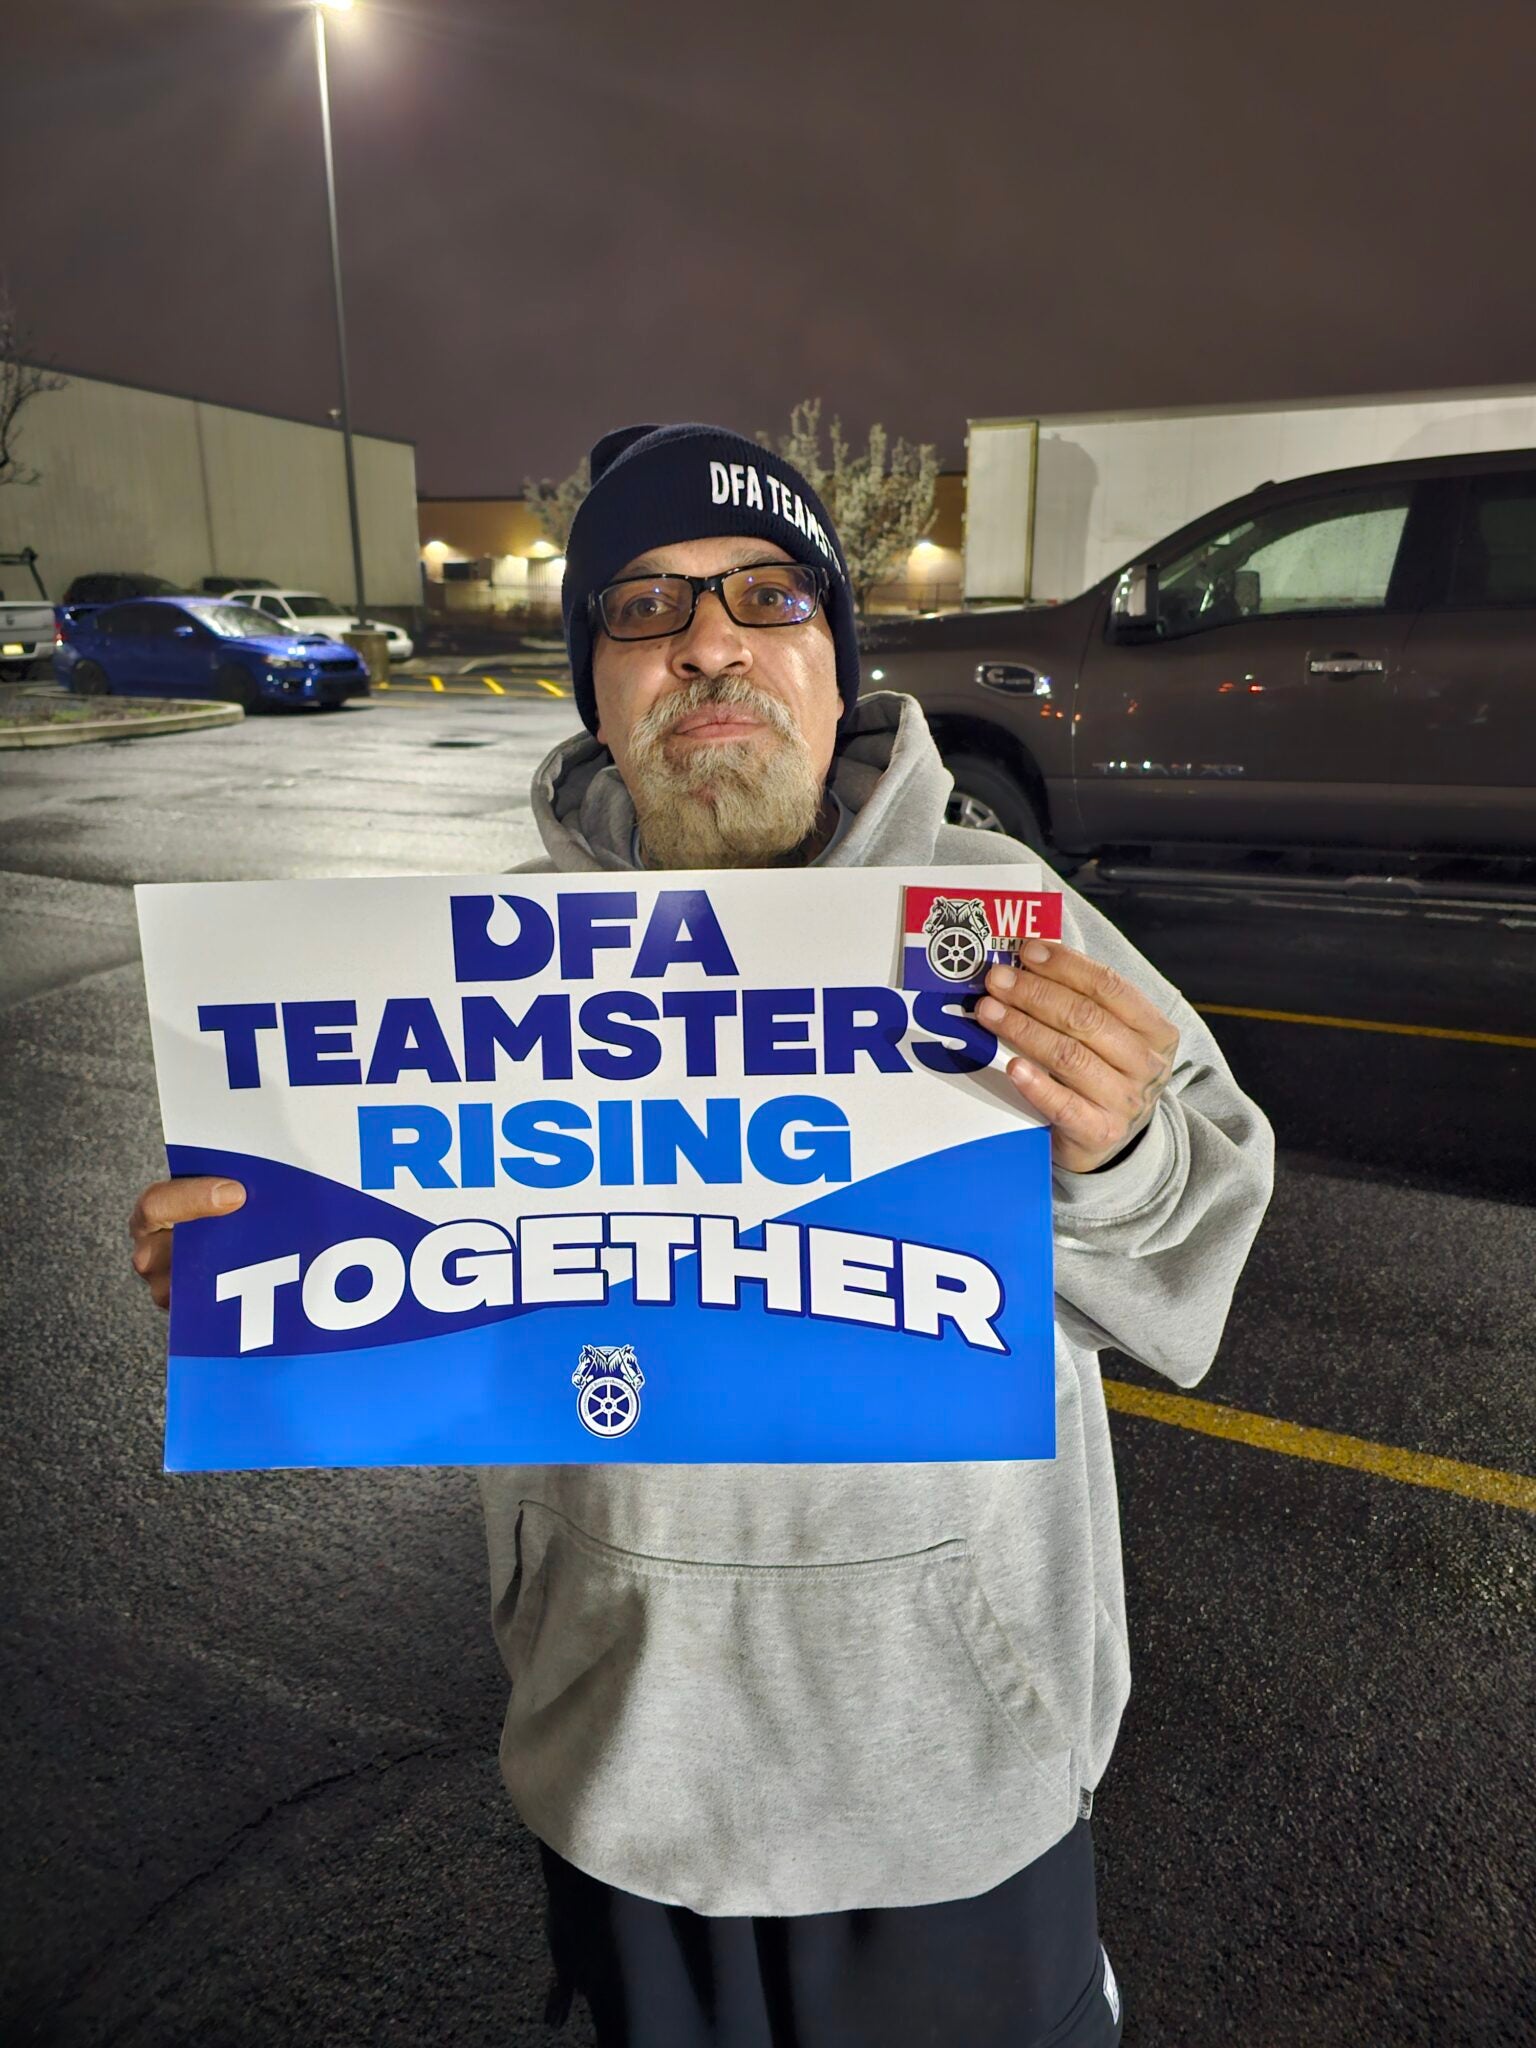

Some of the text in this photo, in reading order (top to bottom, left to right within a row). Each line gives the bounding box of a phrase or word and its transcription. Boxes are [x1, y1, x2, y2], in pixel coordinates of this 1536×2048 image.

[709, 461, 763, 511] DFA
[452, 890, 737, 982] DFA
[994, 898, 1042, 938] WE
[198, 986, 999, 1088] TEAMSTERS
[357, 1094, 853, 1191] RISING
[215, 1213, 1009, 1354] TOGETHER
